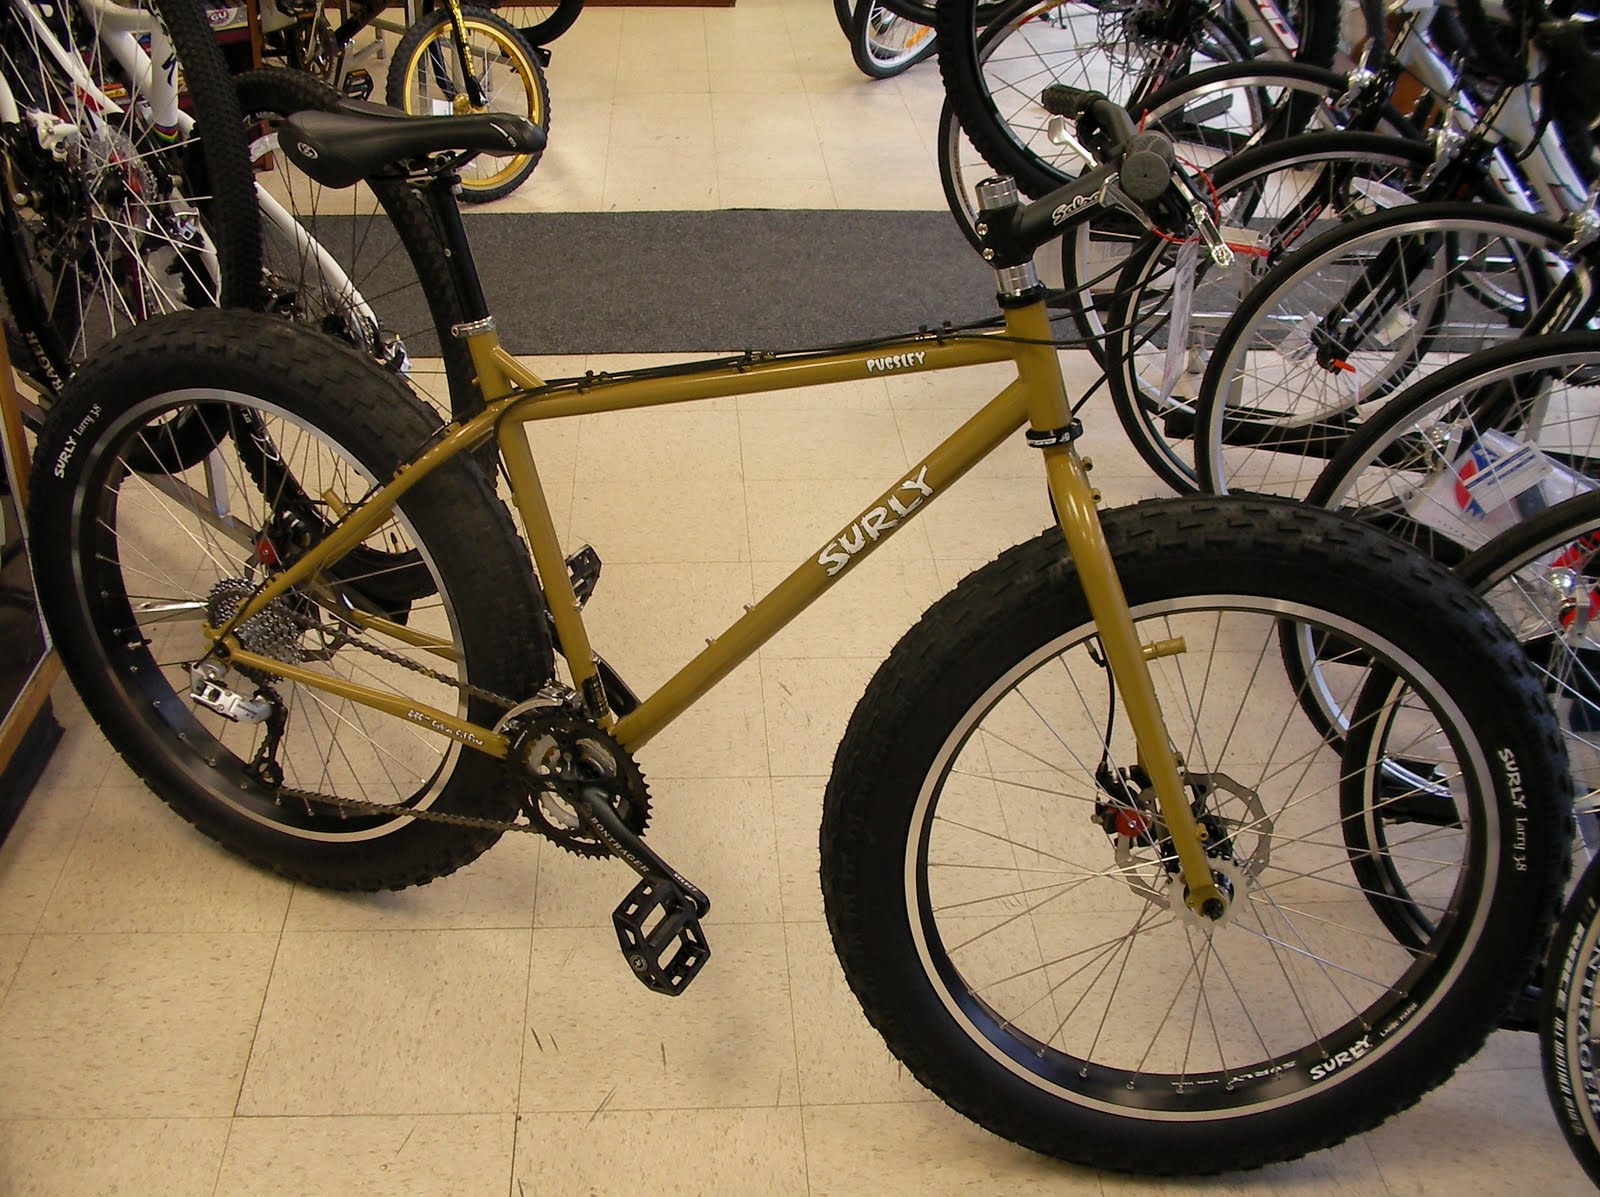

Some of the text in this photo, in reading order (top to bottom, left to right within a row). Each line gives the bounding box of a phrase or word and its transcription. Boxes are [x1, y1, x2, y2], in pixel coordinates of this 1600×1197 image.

[866, 351, 926, 372] PUGSLEY
[54, 435, 77, 479] SURLY
[817, 464, 934, 577] SURLY
[1498, 747, 1527, 809] SURLY
[591, 817, 650, 873] BONTRAGER
[1309, 1034, 1374, 1081] SURLY
